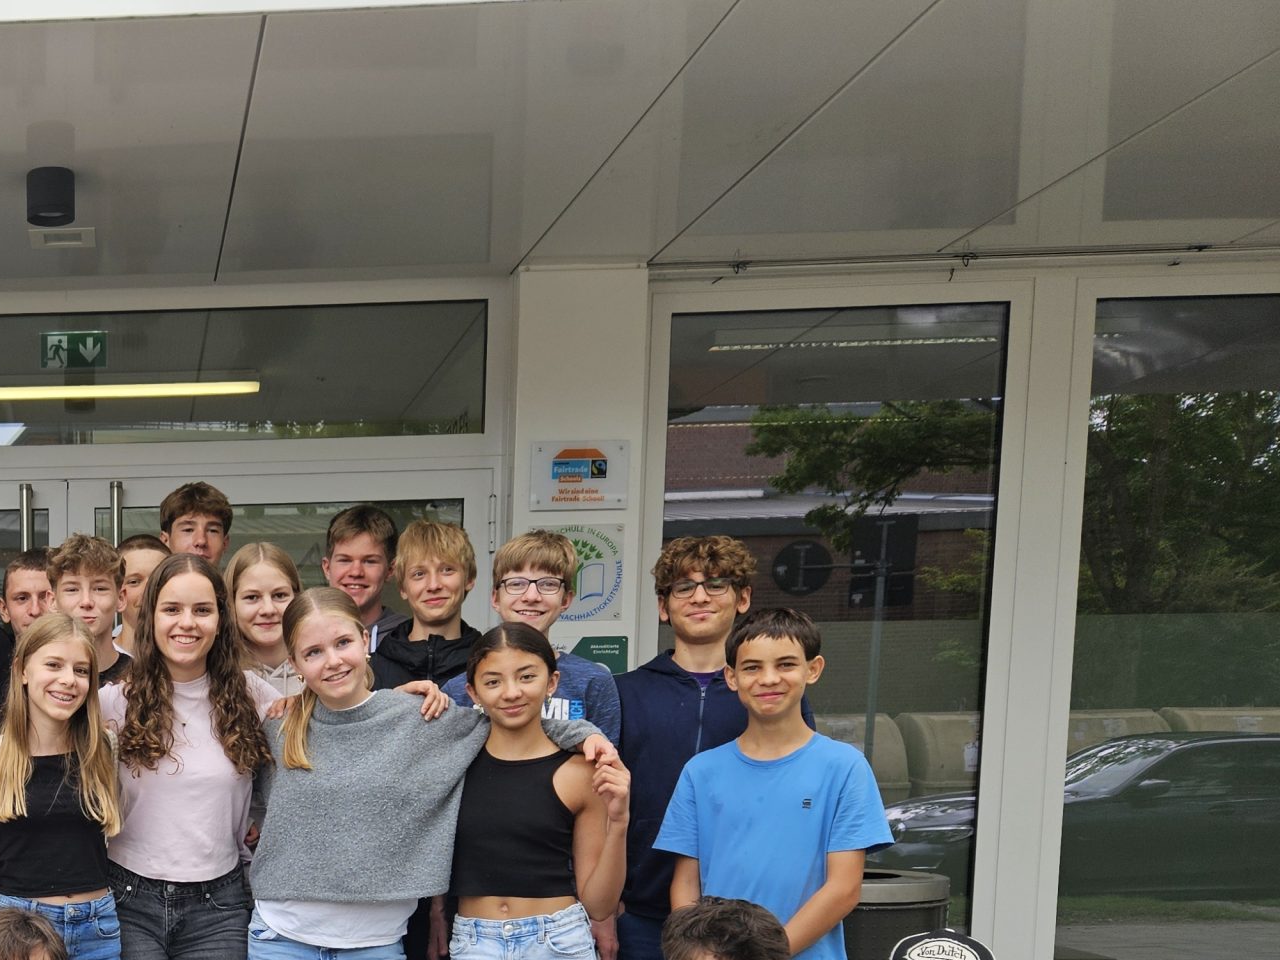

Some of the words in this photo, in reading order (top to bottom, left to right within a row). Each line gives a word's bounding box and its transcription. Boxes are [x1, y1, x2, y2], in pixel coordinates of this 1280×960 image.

[553, 465, 588, 473] Fairtrade
[587, 527, 596, 535] IN
[595, 531, 619, 556] EUROPA
[920, 946, 936, 956] Von
